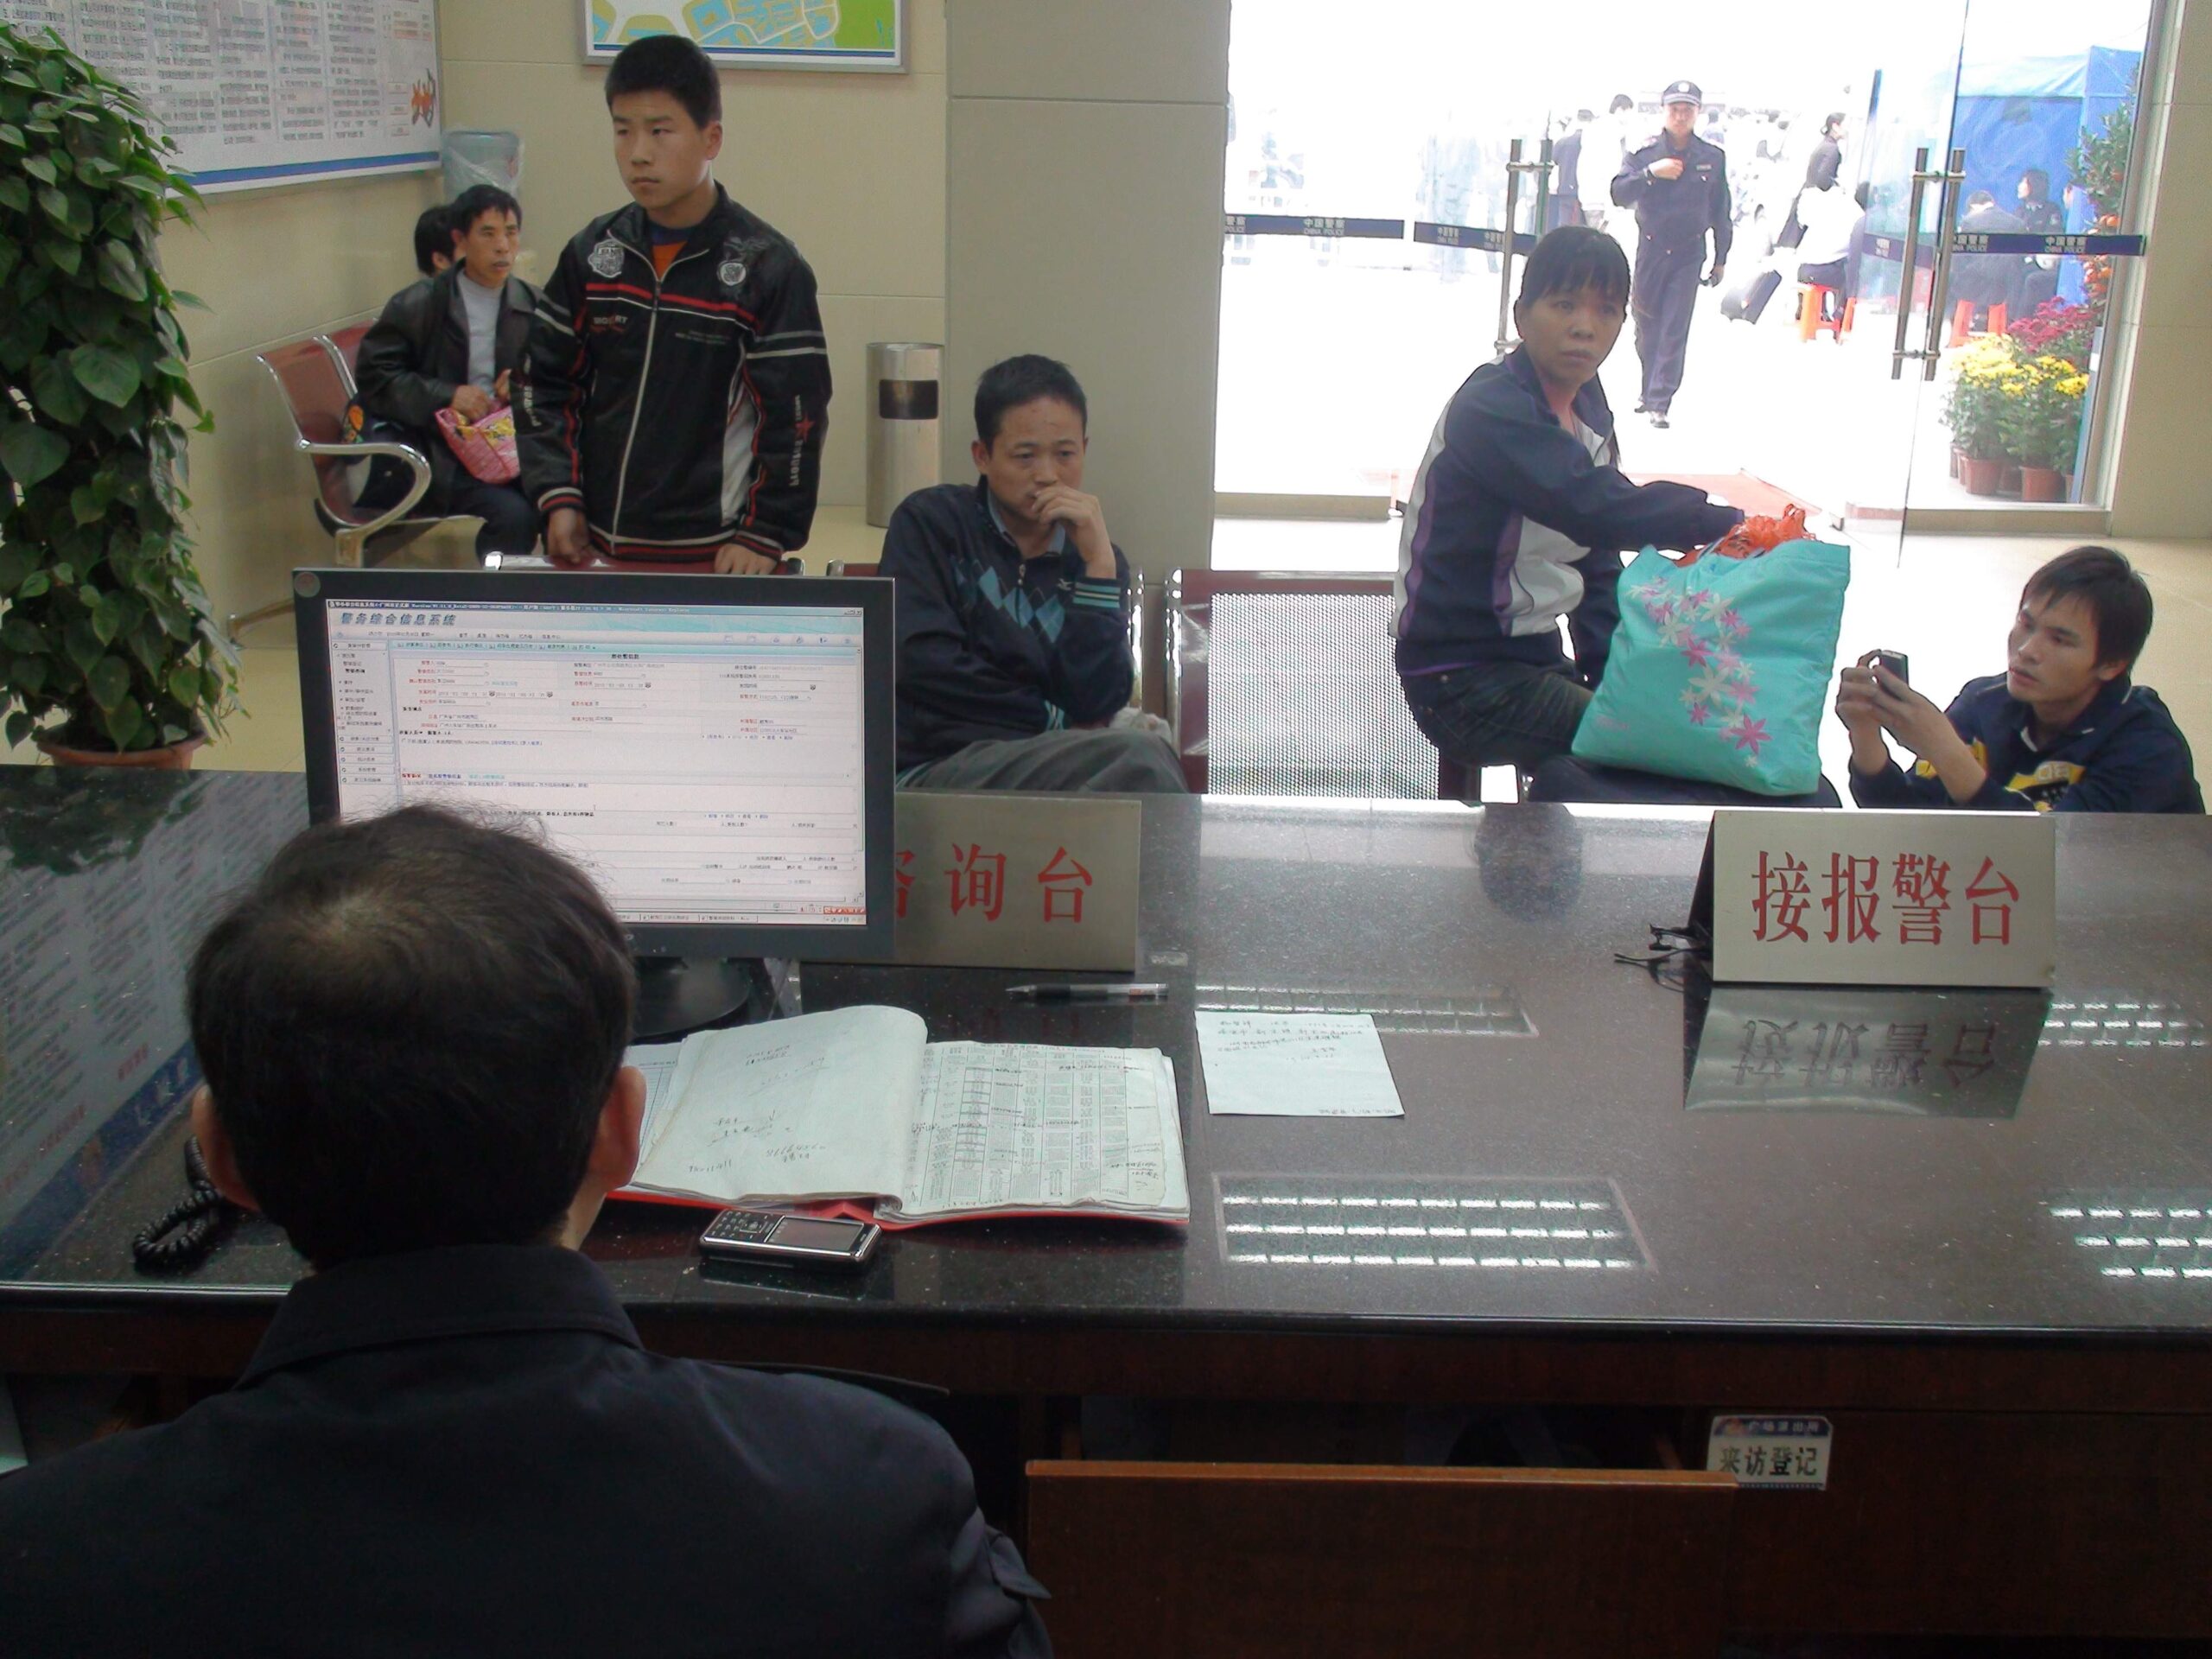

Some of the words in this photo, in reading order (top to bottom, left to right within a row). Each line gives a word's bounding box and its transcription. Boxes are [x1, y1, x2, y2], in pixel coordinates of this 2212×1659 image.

[1304, 218, 1345, 228] 中国警察
[2045, 236, 2087, 245] 中国警察
[340, 612, 457, 626] 警务综合信息系统
[1751, 850, 2021, 946] 接报警台
[1719, 1446, 1817, 1476] 来访登记
